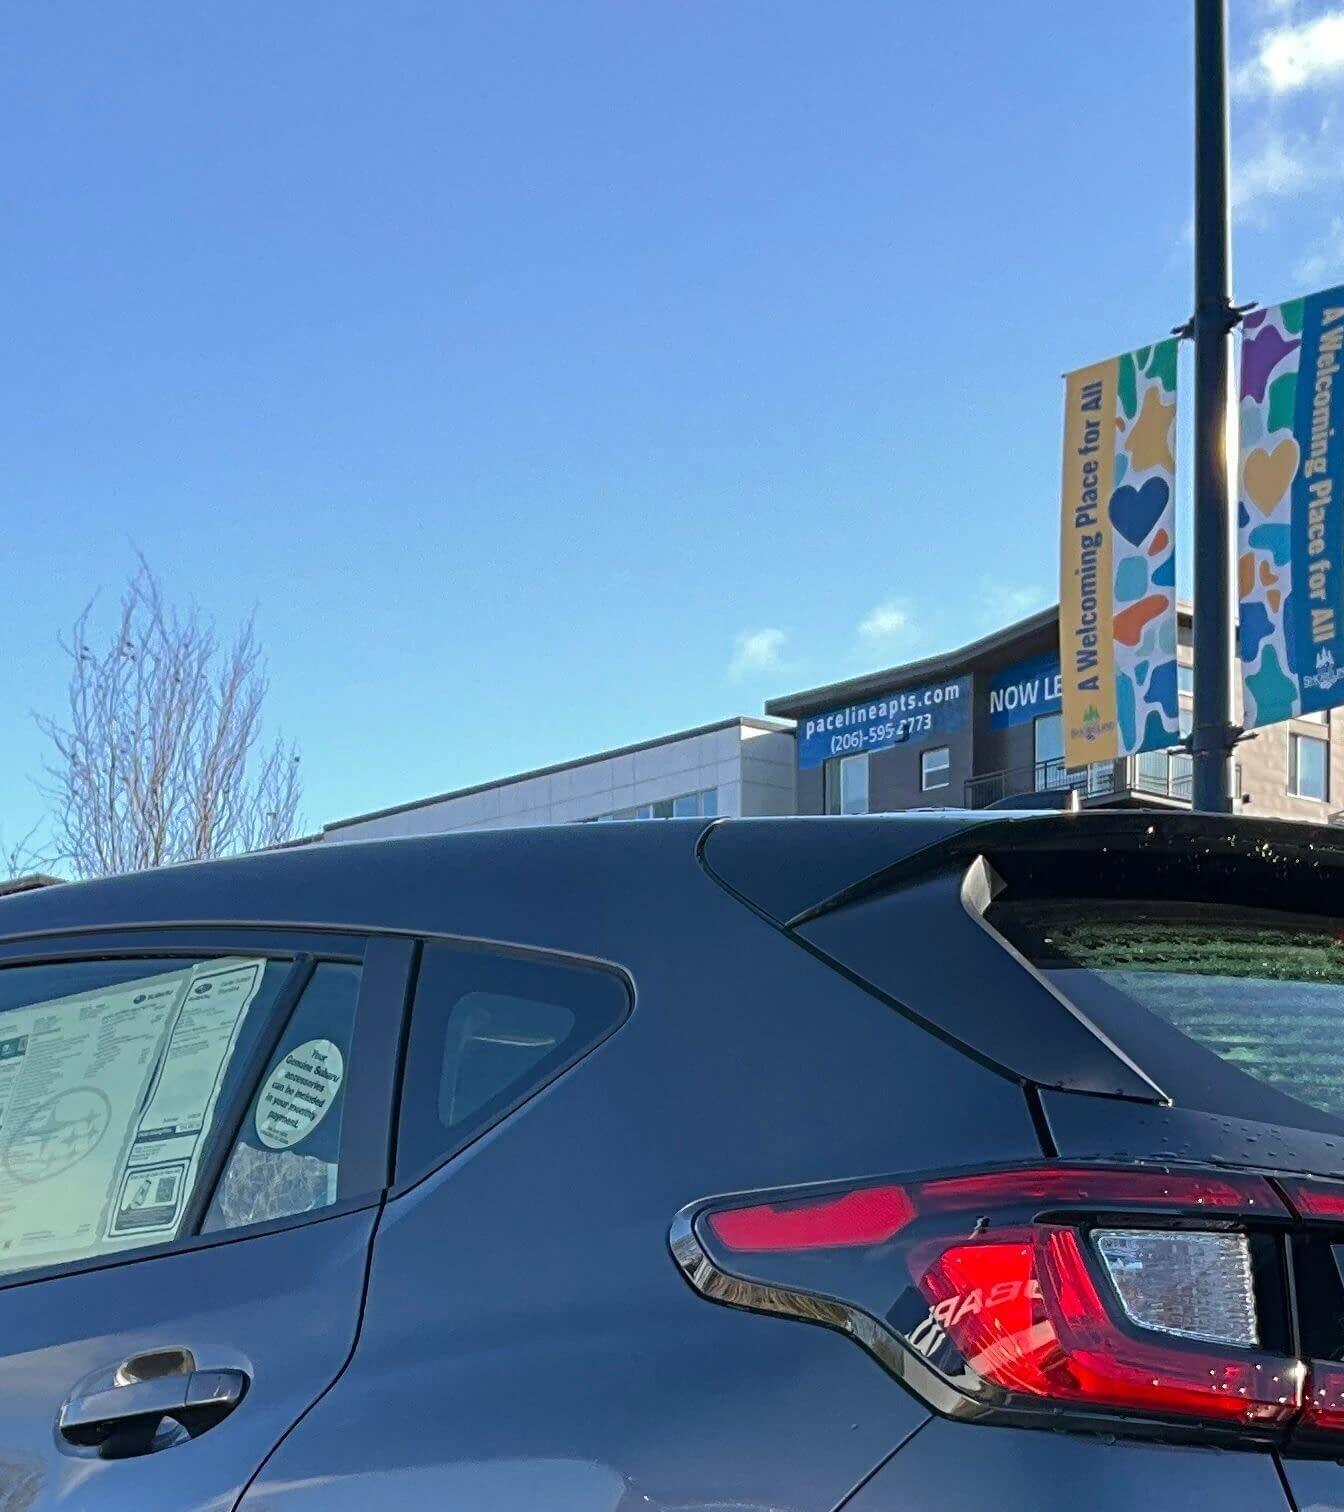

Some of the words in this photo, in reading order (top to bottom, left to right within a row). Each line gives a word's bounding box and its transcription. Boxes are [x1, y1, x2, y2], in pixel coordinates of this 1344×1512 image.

[1080, 380, 1103, 412] All
[1305, 324, 1344, 479] Welcoming
[1077, 419, 1101, 456] for
[1075, 460, 1098, 528] Place
[1309, 479, 1333, 557] Place
[1309, 559, 1332, 601] for
[1075, 531, 1103, 673] Welcoming
[1310, 608, 1336, 643] All
[989, 679, 1040, 714] NOW
[1077, 675, 1100, 691] A
[806, 684, 960, 741] pacelineapts.com
[284, 1071, 326, 1093] accessories
[285, 1054, 314, 1073] Genuine
[313, 1065, 341, 1083] Subaru
[271, 1081, 285, 1092] can
[284, 1084, 295, 1096] be
[294, 1089, 326, 1108] included
[287, 1103, 317, 1122] monthly
